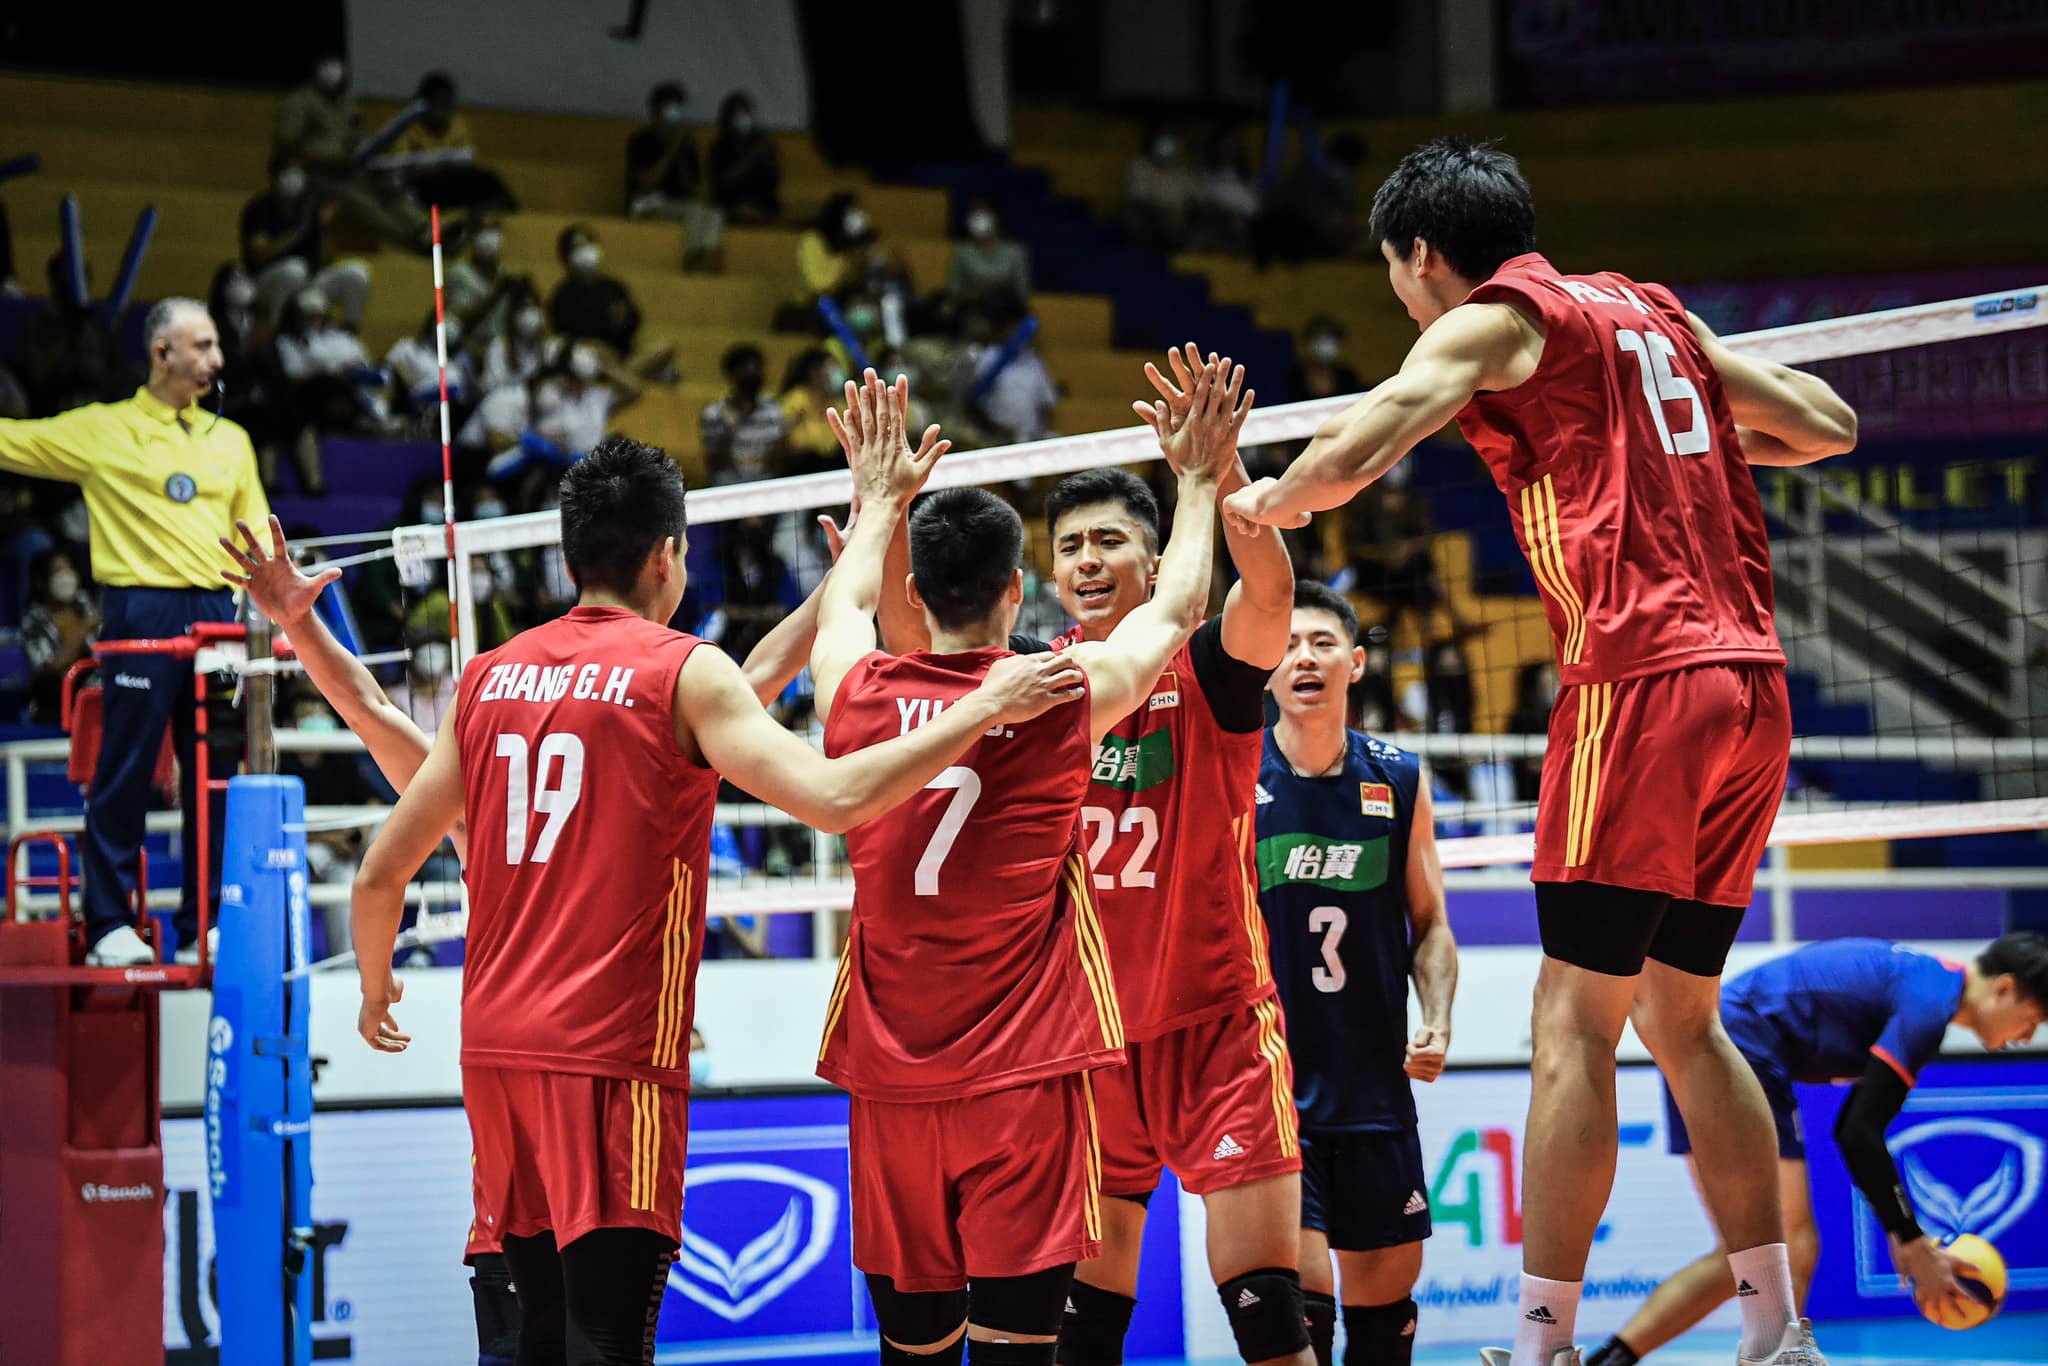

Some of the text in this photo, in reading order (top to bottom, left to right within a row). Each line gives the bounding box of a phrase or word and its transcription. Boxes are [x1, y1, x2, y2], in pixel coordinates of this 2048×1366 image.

[1616, 328, 1710, 456] 15
[479, 663, 635, 708] ZHANG G.H.
[1150, 695, 1175, 707] CHN
[495, 732, 585, 865] 19
[913, 766, 982, 896] 7
[1080, 806, 1159, 889] 22
[1284, 844, 1364, 880] 怡寶
[1308, 905, 1348, 993] 3
[208, 1057, 228, 1199] Senoh
[97, 1184, 153, 1200] Senoh
